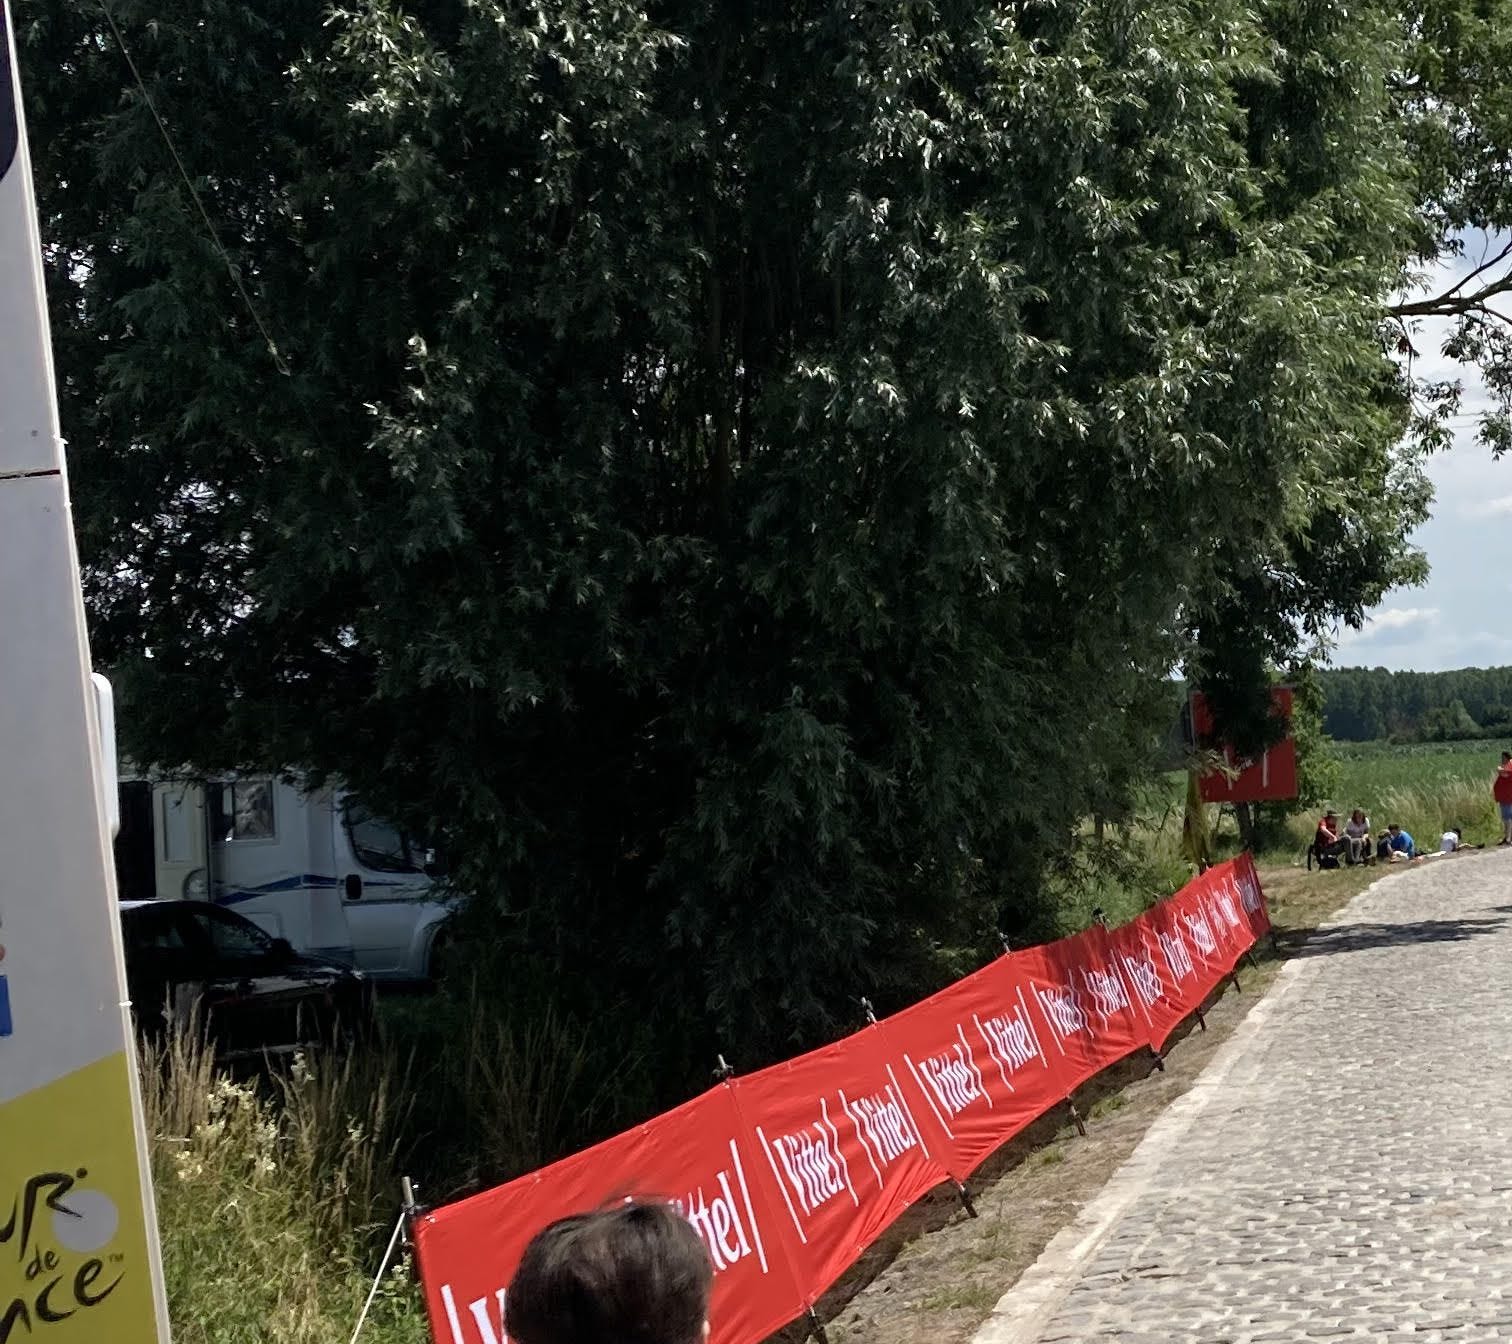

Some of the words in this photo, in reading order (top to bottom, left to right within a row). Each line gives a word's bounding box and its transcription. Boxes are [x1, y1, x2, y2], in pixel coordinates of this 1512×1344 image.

[984, 1005, 1039, 1076] Vittel
[918, 1043, 982, 1120] Vittel
[851, 1084, 918, 1167] Vittel
[773, 1122, 846, 1217] Vittel
